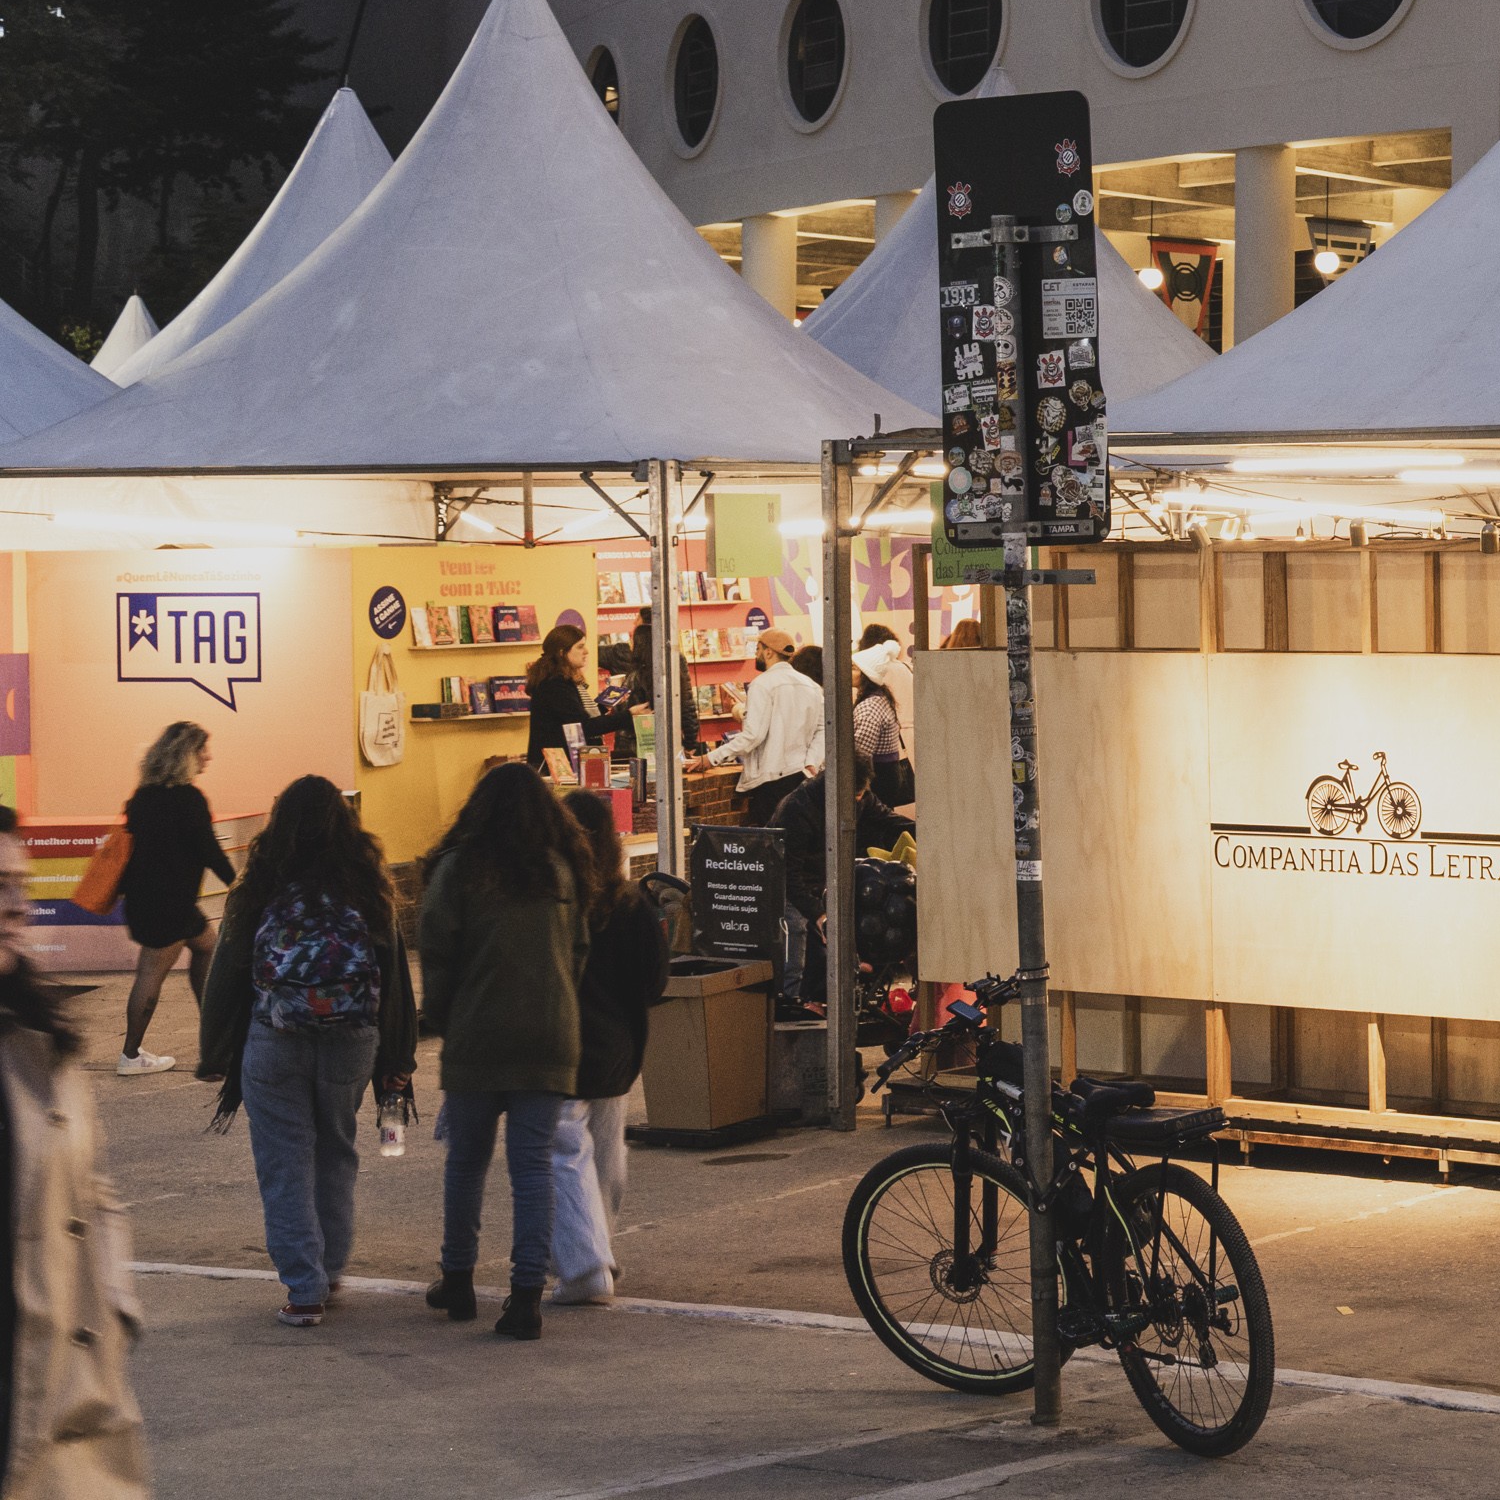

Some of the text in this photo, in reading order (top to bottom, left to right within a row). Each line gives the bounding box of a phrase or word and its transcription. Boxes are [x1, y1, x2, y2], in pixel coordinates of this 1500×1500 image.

[1043, 282, 1061, 292] CET
[944, 286, 976, 306] 1913
[1048, 525, 1076, 534] TAMPA
[439, 560, 473, 576] Vem
[439, 579, 522, 597] com a TAG!
[373, 593, 396, 616] ASSINE
[167, 610, 247, 665] TAG
[34, 836, 71, 846] melhor
[723, 843, 746, 855] Não
[705, 858, 765, 873] Recicláveis
[707, 881, 763, 892] Restos de comida
[714, 893, 756, 903] Guardanapos
[712, 903, 758, 914] Materiais sujos
[720, 920, 750, 932] valora
